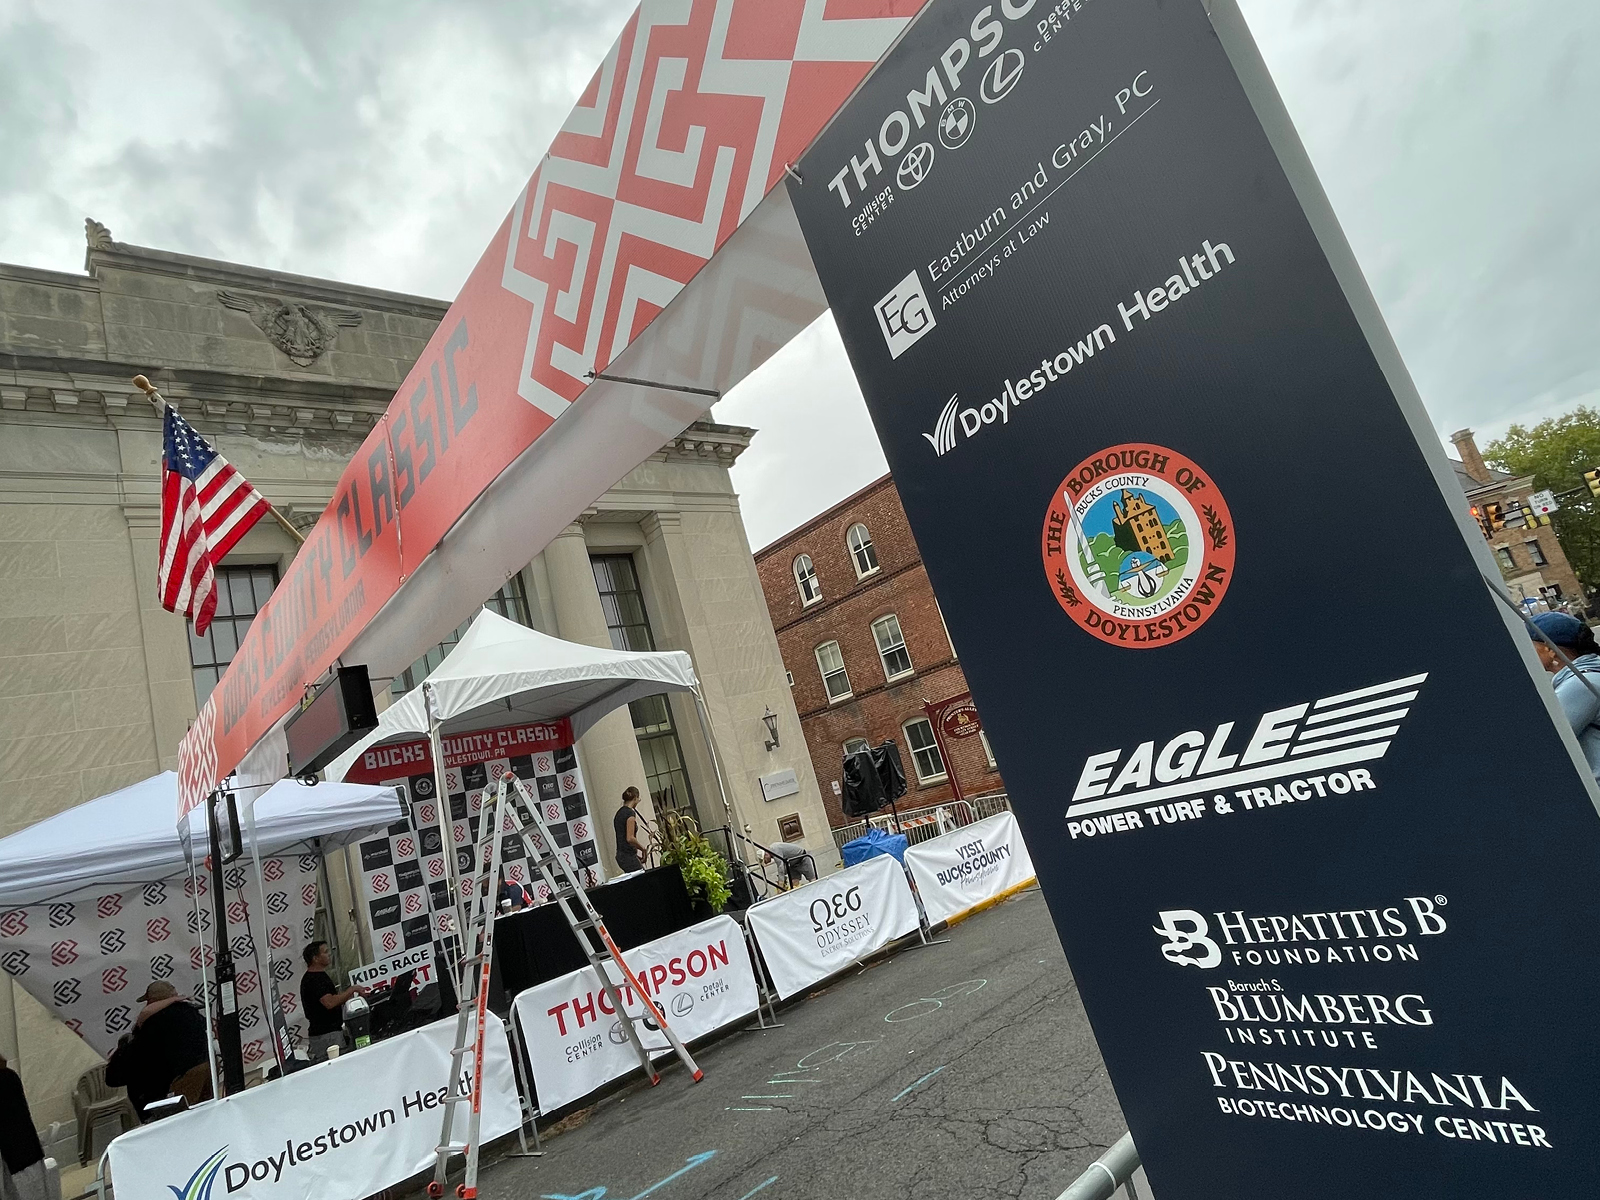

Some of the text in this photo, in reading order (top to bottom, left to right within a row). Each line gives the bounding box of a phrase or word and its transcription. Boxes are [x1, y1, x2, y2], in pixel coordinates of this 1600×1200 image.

[927, 69, 1154, 282] Eastburn and Gray, PC
[851, 185, 892, 229] Collision
[855, 194, 895, 237] CENTER
[941, 211, 1051, 311] Attorneys at Law
[879, 293, 930, 338] EG
[959, 239, 1237, 438] Doylestown Health
[261, 524, 334, 684] COUNTY
[336, 315, 479, 582] CLASSIC
[1047, 449, 1206, 557] THE BOROUGH OF
[1076, 475, 1150, 516] BUCKS COUNTY
[1084, 562, 1227, 643] DOYLESTOWN
[1113, 577, 1194, 618] PENNSYLVANIA
[364, 725, 560, 770] BUCKS OUNTY CLASSIC
[494, 747, 507, 757] PA
[1071, 702, 1311, 802] EAGLE
[1066, 767, 1377, 840] POWER TURF & TRACTOR
[936, 843, 1011, 886] BUCKS COUNTY
[955, 839, 986, 860] VISIT
[816, 912, 870, 949] ODYSSEY
[1213, 907, 1408, 946] HEPATITIS
[352, 949, 430, 985] KIDS RACE
[1231, 943, 1420, 967] FOUNDATION
[700, 984, 730, 1002] CENTER
[702, 978, 724, 993] Detail
[1205, 985, 1435, 1027] BLUMBERG
[1227, 978, 1285, 993] Baruch S.
[565, 1033, 602, 1056] Collision
[567, 1041, 603, 1064] CENTER
[1224, 1027, 1379, 1051] INSTITUTE
[1200, 1051, 1541, 1113] PENNSYLVANIA
[225, 1070, 473, 1194] Doylestown Heath
[1217, 1096, 1554, 1149] BIOTECHNOLOGY CENTER
